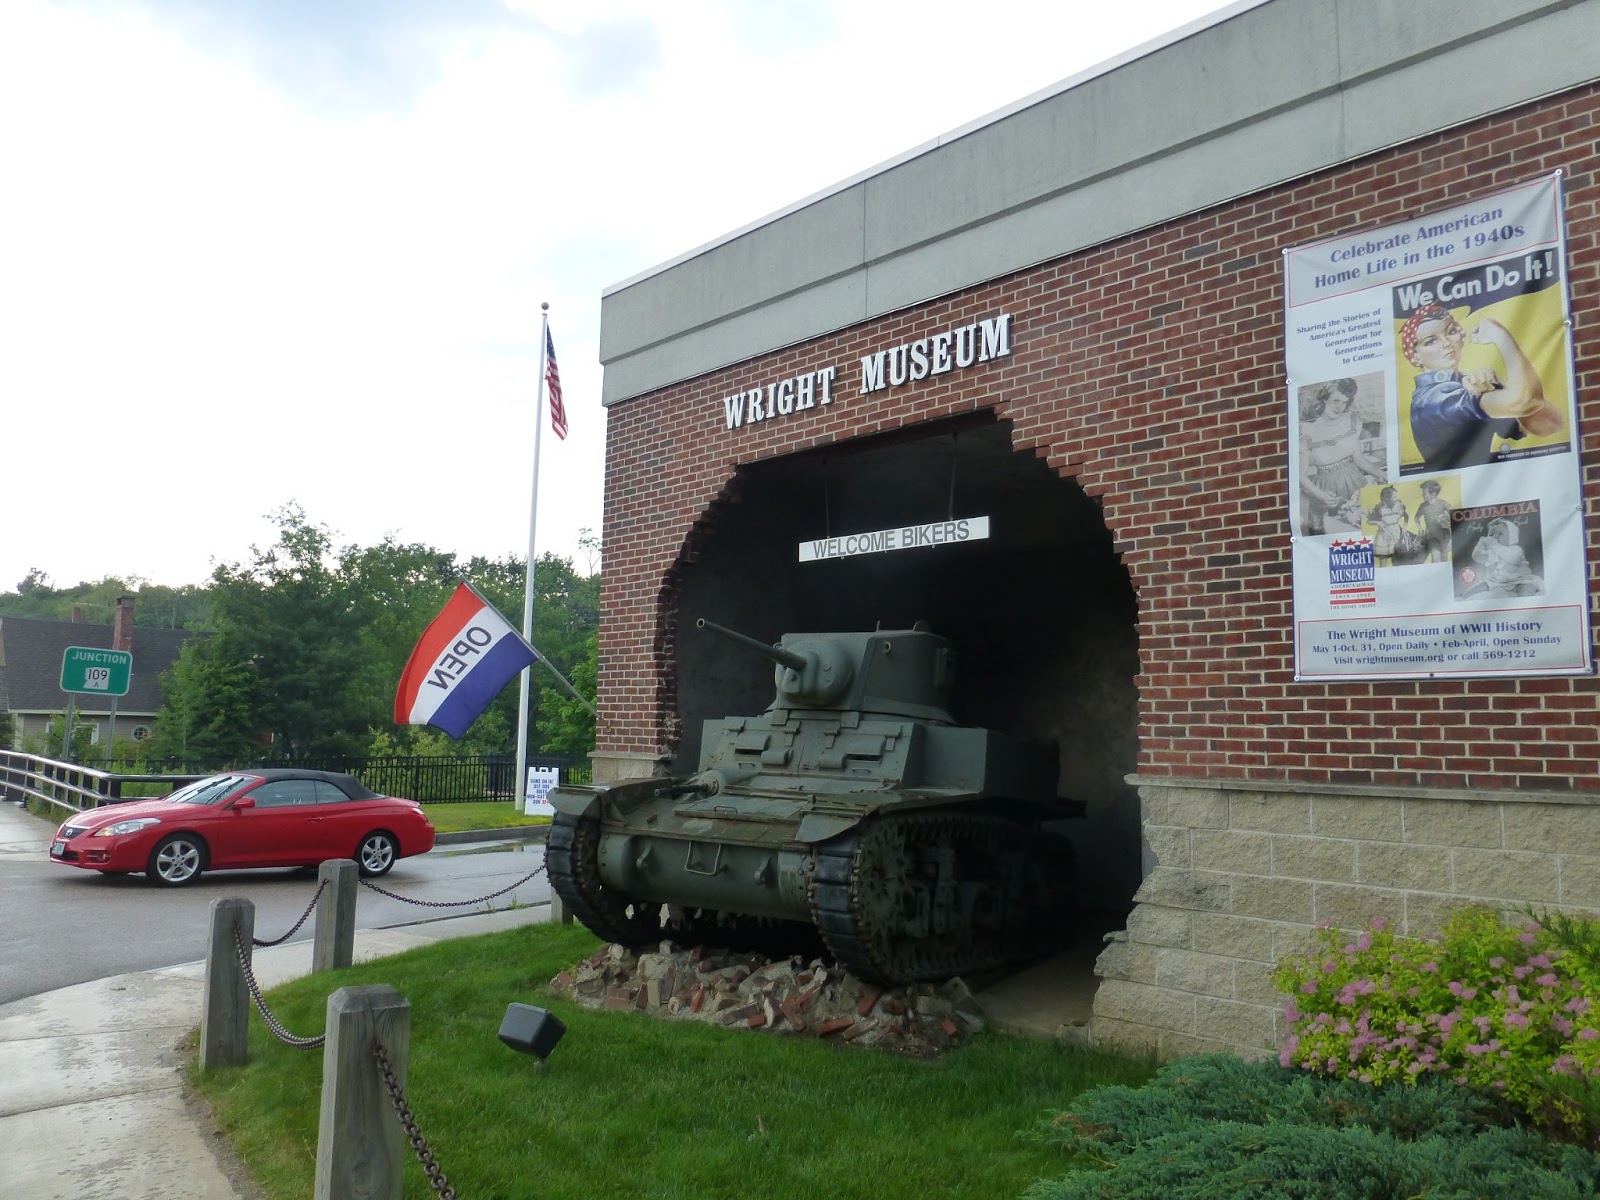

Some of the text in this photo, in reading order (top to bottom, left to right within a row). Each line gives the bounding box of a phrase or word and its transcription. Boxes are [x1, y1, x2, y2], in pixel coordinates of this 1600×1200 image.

[1331, 208, 1502, 263] Celebrate American
[1314, 224, 1525, 288] Home Life in the 1940s
[1397, 251, 1554, 310] We Can Do It!
[1296, 308, 1382, 334] Sharing the Stories of
[1309, 319, 1382, 341] America's Greatest
[1325, 330, 1382, 348] Generation for
[1334, 341, 1382, 356] Generations
[724, 314, 1013, 430] WRIGHT MUSEUM
[1452, 502, 1538, 522] COLUMBIA
[813, 520, 970, 558] WELCOME BIKERS
[1331, 551, 1372, 566] WRIGHT
[1330, 568, 1374, 582] MUSEUM
[1327, 620, 1543, 641] The Wright Museum of WWII History
[1312, 634, 1562, 654] May 1-Oct. 31, Open Daily Feb-April, Open Sunday
[72, 652, 127, 664] JUNCTION
[1334, 656, 1353, 664] Visit
[1356, 653, 1444, 665] wrightmuseum.org
[1462, 651, 1480, 660] call
[1482, 649, 1536, 660] 569-1212
[88, 669, 108, 680] 109
